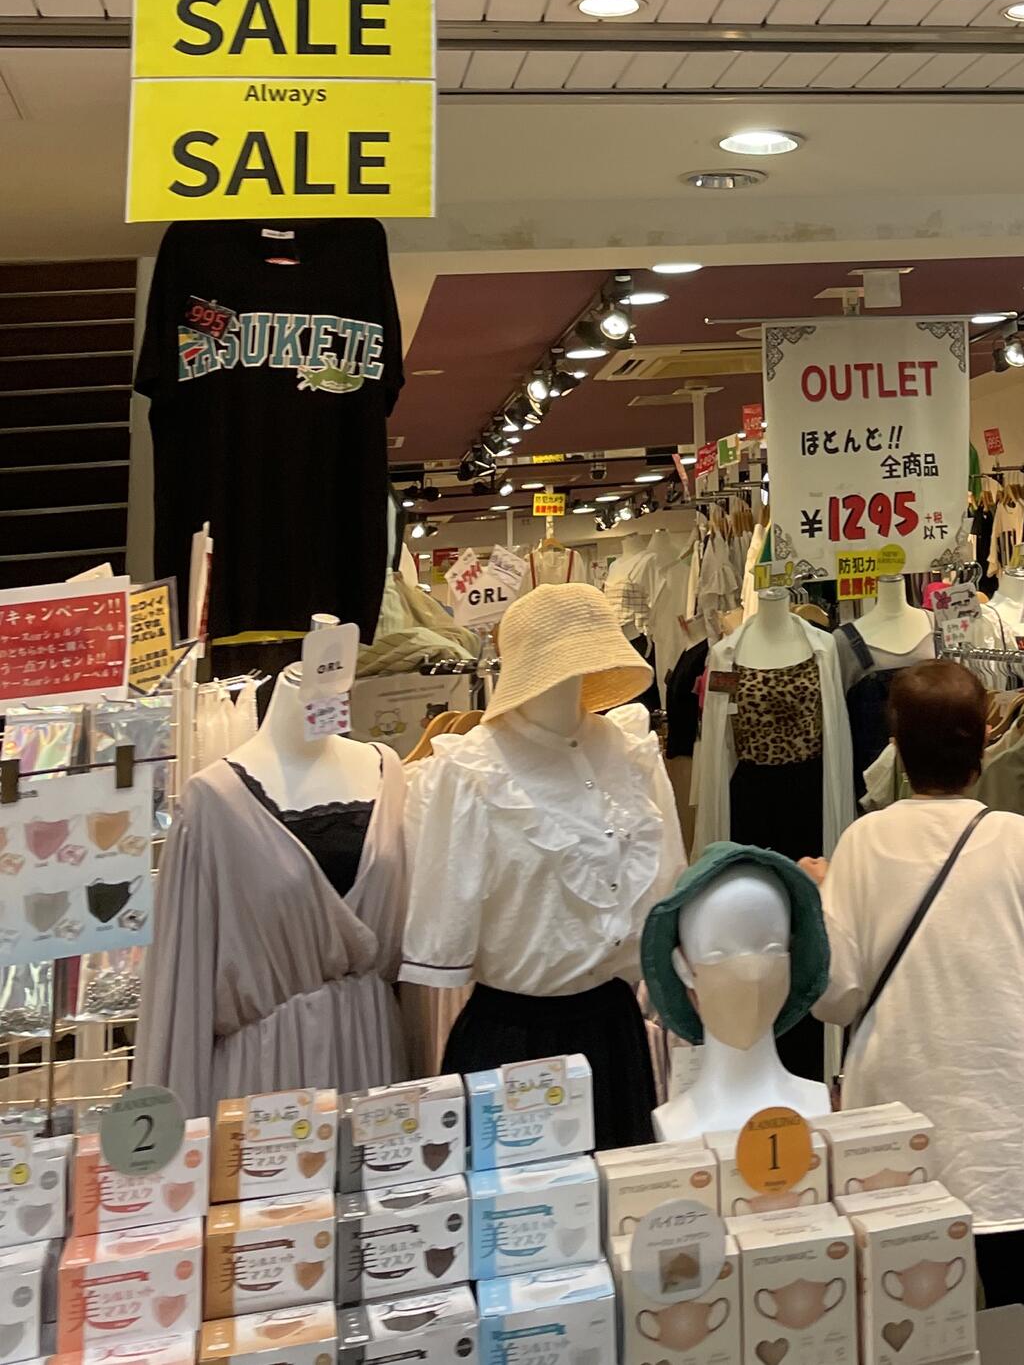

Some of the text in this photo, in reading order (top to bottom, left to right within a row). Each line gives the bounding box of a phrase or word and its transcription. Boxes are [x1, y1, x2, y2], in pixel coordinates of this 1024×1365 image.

[244, 84, 327, 106] Always
[168, 131, 390, 197] SALE
[801, 361, 938, 402] OUTLET
[801, 426, 903, 456] ほとんど!!
[880, 452, 939, 480] 全商品
[923, 524, 949, 540] 以下
[468, 587, 508, 605] GRL
[0, 598, 121, 627] キャンペーン!!
[131, 1114, 155, 1153] 2
[767, 1133, 780, 1171] 1
